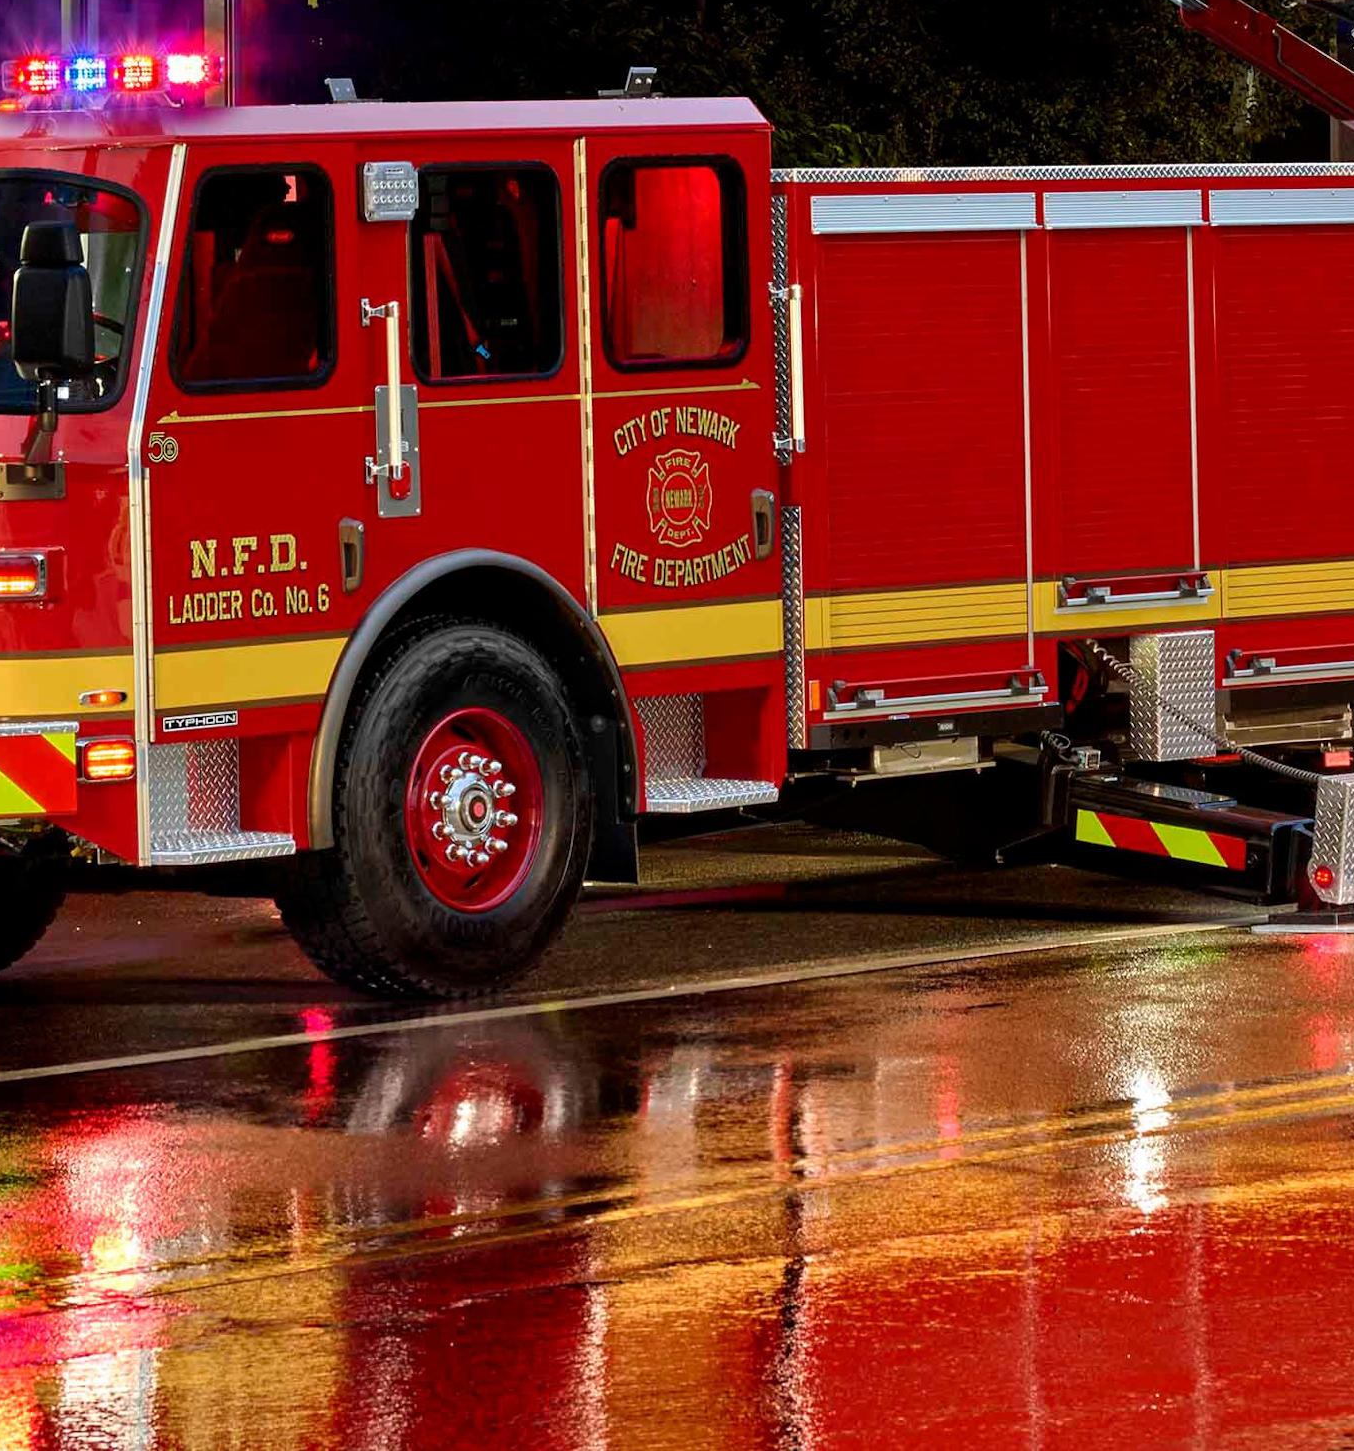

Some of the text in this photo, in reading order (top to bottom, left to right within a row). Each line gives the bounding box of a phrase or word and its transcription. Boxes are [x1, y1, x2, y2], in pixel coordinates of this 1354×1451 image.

[614, 407, 740, 456] CITY OF NEWARK
[665, 456, 690, 468] FIRE
[666, 489, 693, 508] NEWARK
[667, 527, 694, 538] DEPT.
[190, 534, 308, 578] N.F.D.
[610, 534, 751, 587] FIRE DEPARTMENT
[169, 583, 329, 624] LADDER Co. No. 6
[165, 714, 235, 729] TYPHOON
